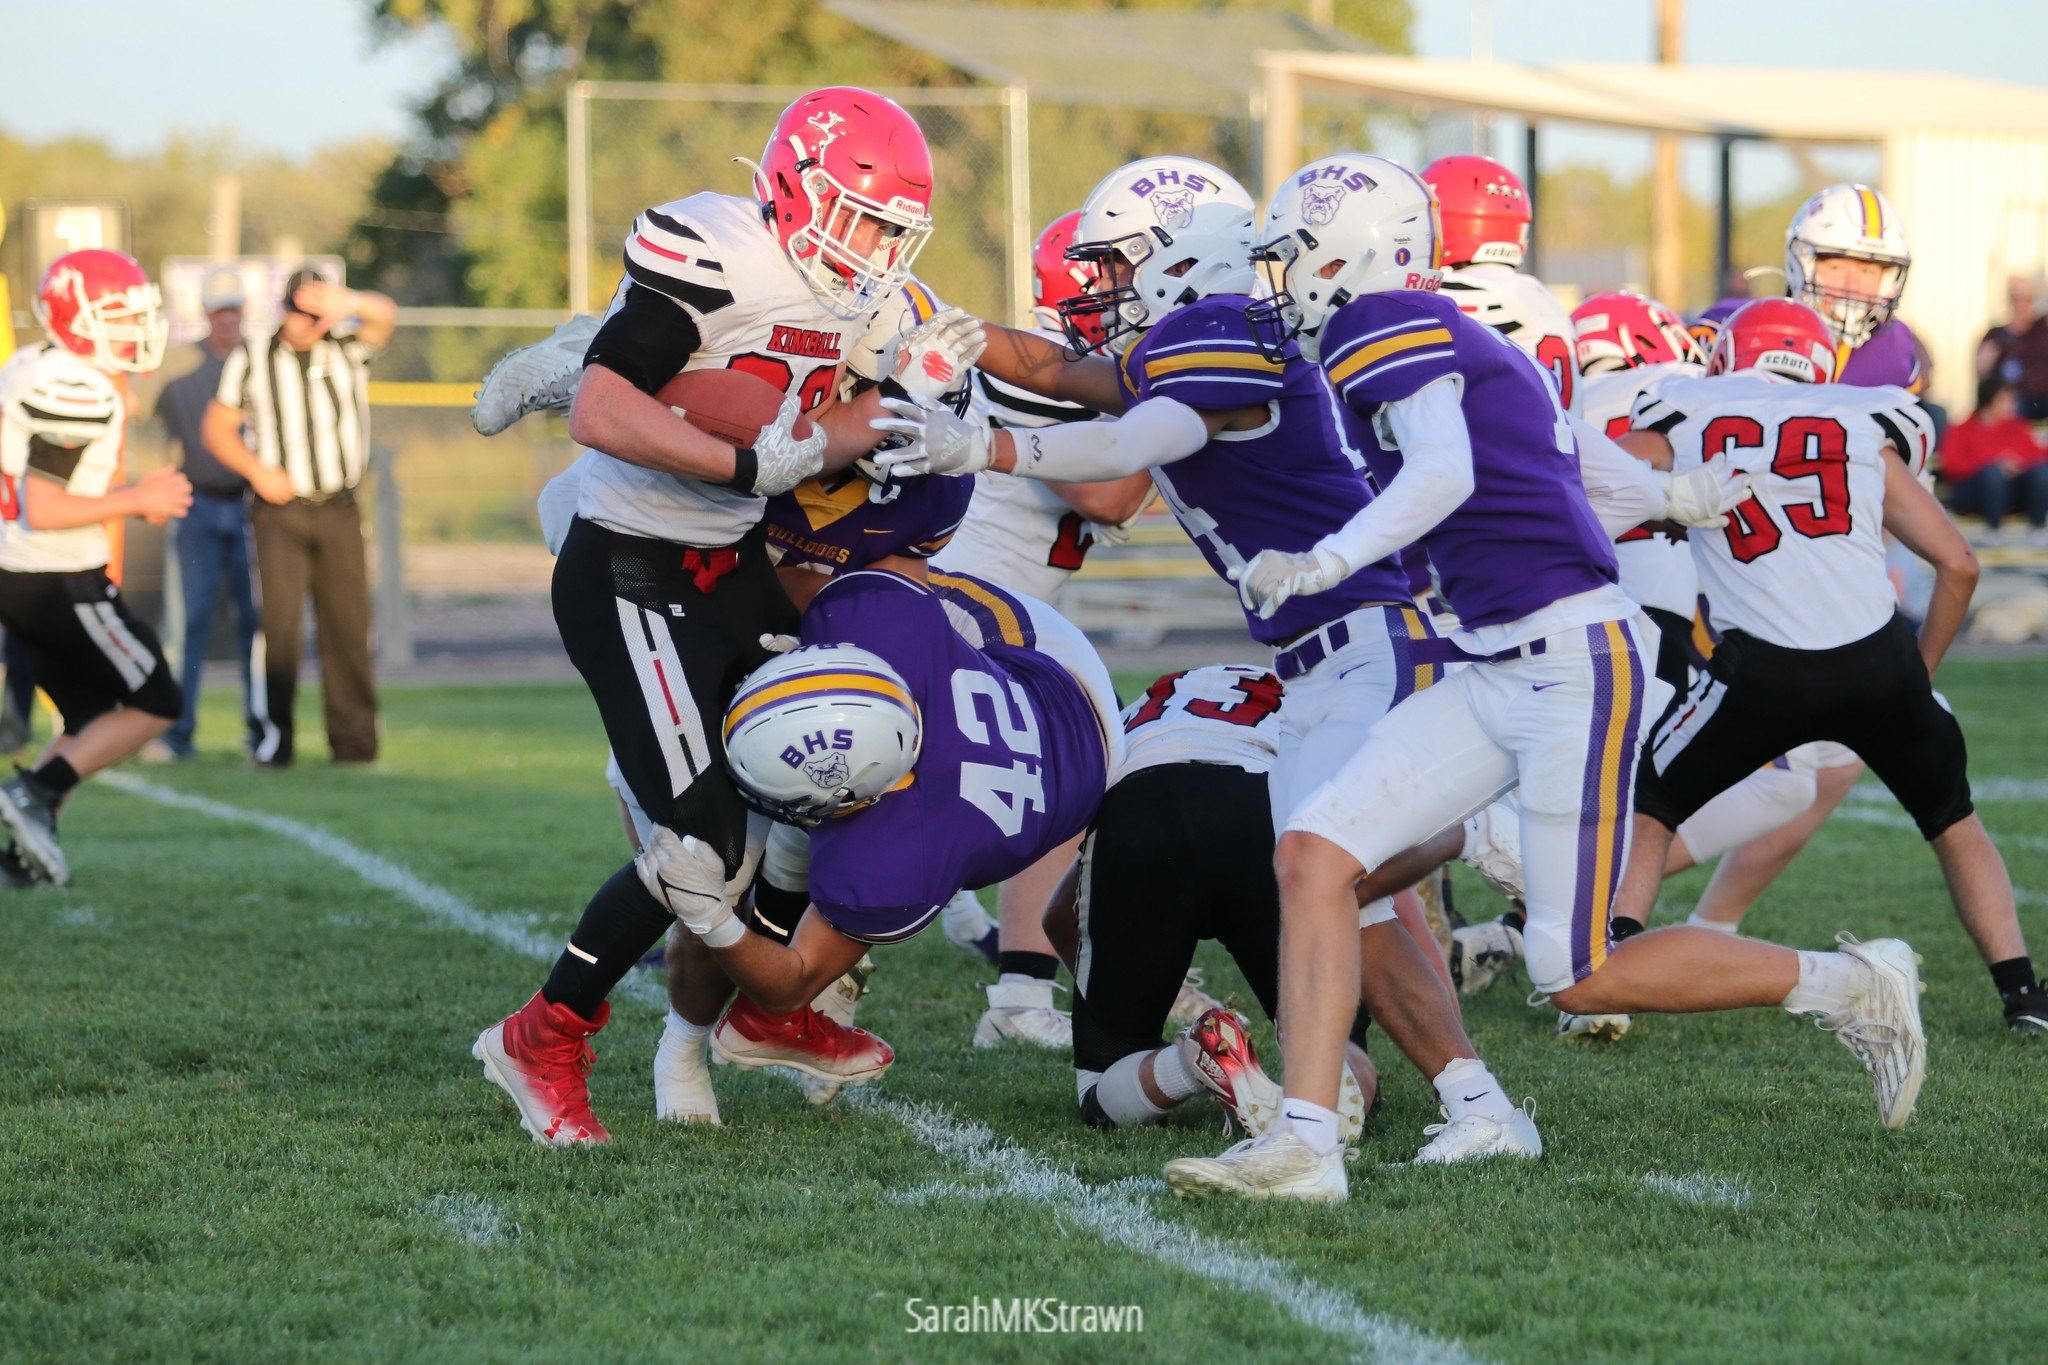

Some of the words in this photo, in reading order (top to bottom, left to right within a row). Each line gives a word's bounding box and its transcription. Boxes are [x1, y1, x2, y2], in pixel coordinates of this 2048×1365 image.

[1129, 170, 1206, 198] BHS
[1298, 165, 1371, 192] BHS
[766, 324, 842, 360] KIMBALL
[1763, 354, 1809, 371] schutt
[1702, 415, 1853, 564] 69
[767, 523, 851, 564] BULLDOGS
[779, 728, 854, 769] BHS
[950, 668, 1046, 838] 42
